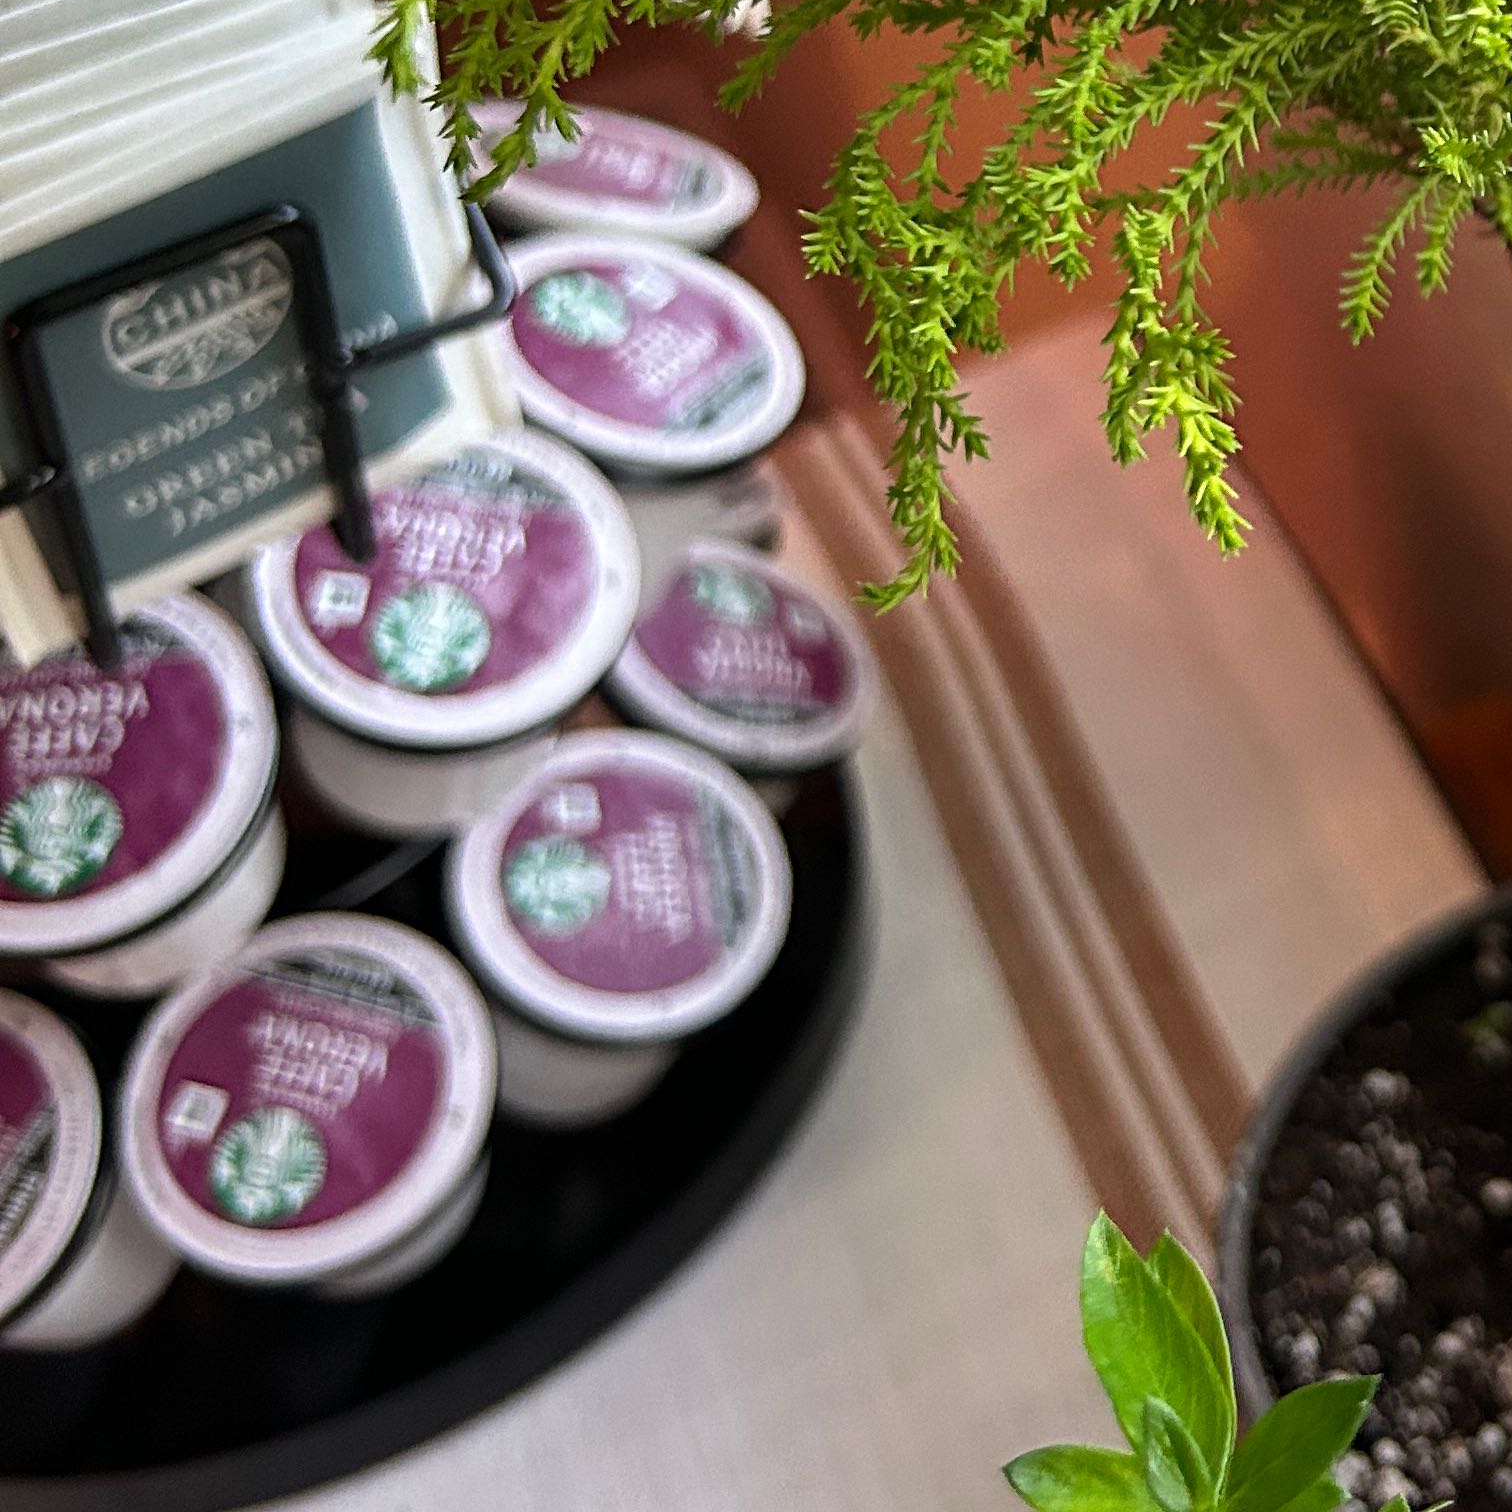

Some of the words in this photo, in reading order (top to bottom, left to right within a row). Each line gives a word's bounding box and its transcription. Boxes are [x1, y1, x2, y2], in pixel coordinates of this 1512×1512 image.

[112, 256, 283, 356] CHINA
[123, 431, 274, 519] GREEN
[168, 438, 328, 537] JASMIN
